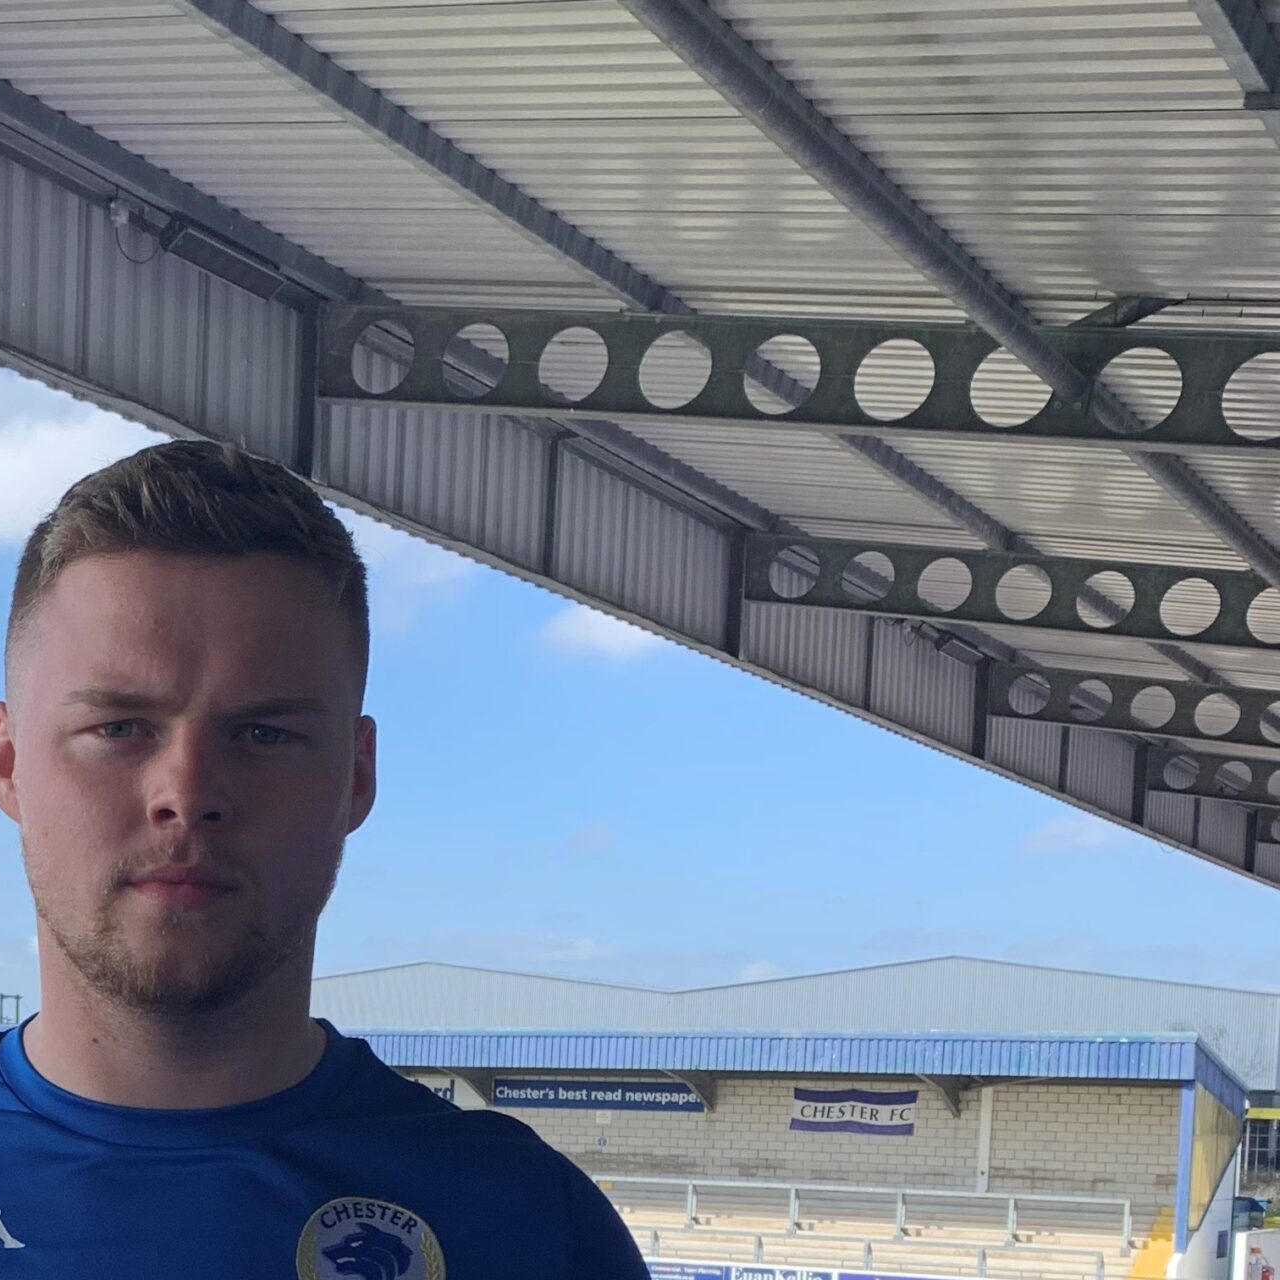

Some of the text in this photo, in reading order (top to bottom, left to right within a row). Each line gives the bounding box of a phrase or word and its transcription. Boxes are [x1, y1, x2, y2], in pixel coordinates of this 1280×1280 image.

[495, 1086, 555, 1100] Chester's
[558, 1087, 589, 1101] best
[591, 1088, 622, 1102] read
[800, 1104, 912, 1122] CHESTER FC
[320, 1202, 418, 1235] CHESTER
